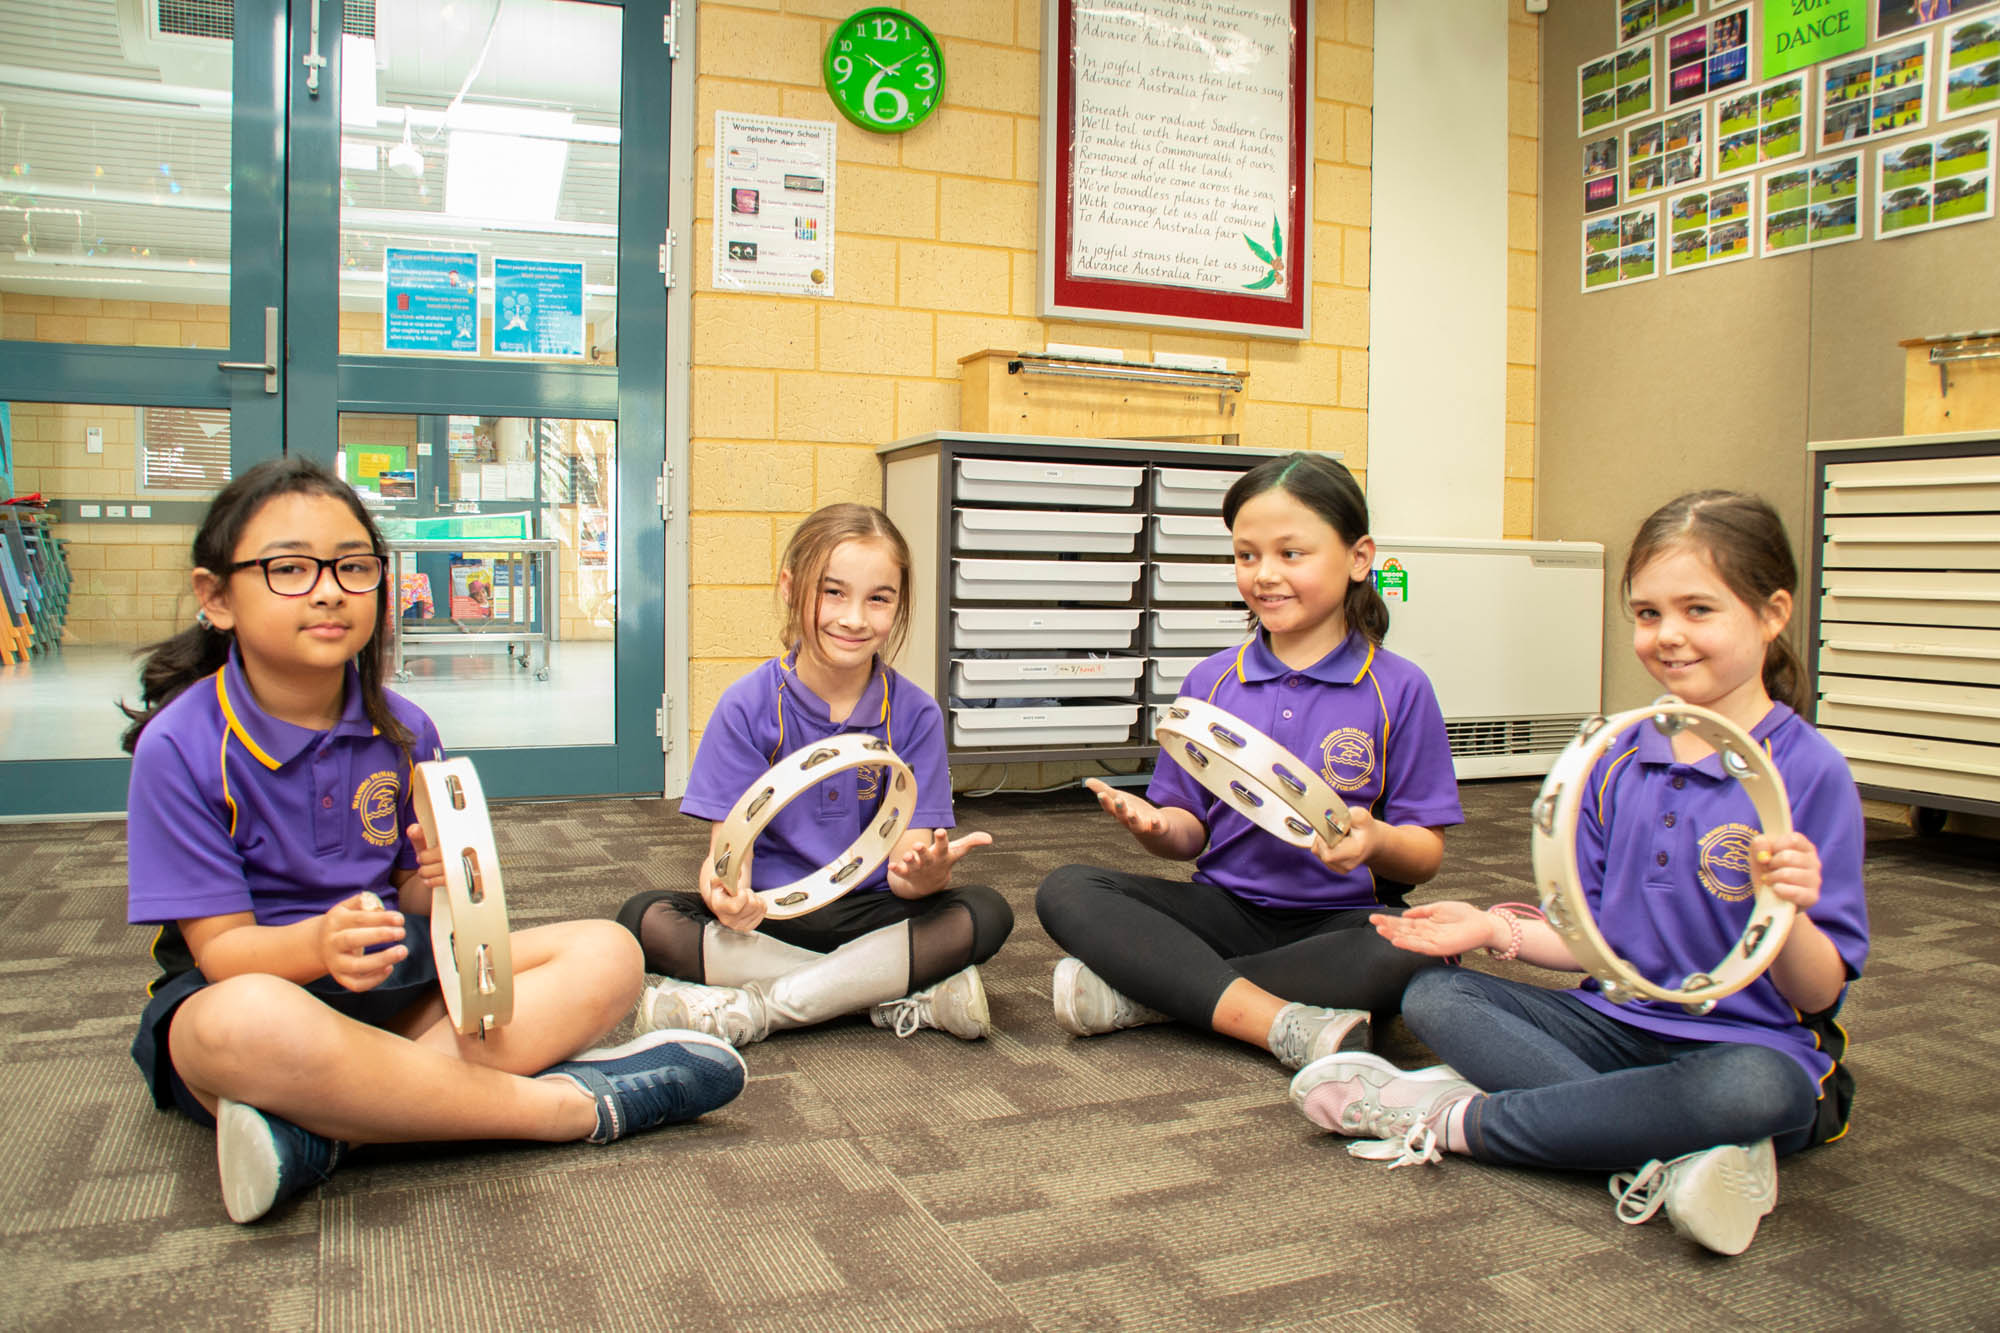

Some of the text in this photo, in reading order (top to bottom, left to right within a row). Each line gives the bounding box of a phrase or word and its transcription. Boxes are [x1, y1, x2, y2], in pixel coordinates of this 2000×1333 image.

[856, 23, 867, 38] 11
[871, 18, 899, 43] 12
[1154, 6, 1178, 19] rich
[1183, 12, 1207, 25] and
[839, 39, 853, 53] 10
[904, 26, 912, 41] 1
[1081, 21, 1137, 43] Advance
[1142, 31, 1203, 54] Australia
[1775, 9, 1851, 55] DANCE
[921, 45, 931, 59] 2
[833, 55, 854, 85] 9
[913, 63, 937, 91] 3
[1083, 52, 1285, 104] In joyful strains then let us sing
[863, 69, 909, 125] 6
[922, 95, 932, 109] 4
[1081, 69, 1229, 106] Advance Australia fair
[732, 122, 821, 140] Warnbro Primary School
[906, 111, 915, 123] 5
[1081, 98, 1285, 144] Beneath our radiant Southern Cross
[746, 135, 778, 147] Splasher
[1081, 114, 1111, 131] We'll
[1115, 122, 1137, 136] toil
[1143, 126, 1170, 141] with
[1175, 127, 1210, 146] heart
[1213, 138, 1237, 151] and
[1080, 130, 1093, 145] To
[1096, 135, 1125, 149] make
[1130, 140, 1152, 153] this
[1155, 141, 1232, 165] Commonwealth
[1235, 155, 1248, 171] of
[1080, 145, 1138, 167] Renowned
[1142, 156, 1155, 170] of
[1158, 158, 1175, 171] all
[1179, 161, 1198, 174] the
[1079, 160, 1099, 176] For
[1101, 165, 1129, 179] those
[1130, 170, 1168, 184] who've
[1169, 178, 1197, 189] come
[1199, 180, 1231, 194] across
[1233, 184, 1251, 198] the
[1079, 177, 1260, 214] We've boundless plains to share
[1079, 193, 1268, 230] With courage let us all combine
[1079, 207, 1093, 222] To
[1098, 209, 1149, 230] Advance
[1153, 217, 1211, 238] Australia
[1076, 255, 1129, 274] Advance
[1131, 261, 1192, 281] Australia
[1078, 239, 1266, 279] In joyful strains then let us sing
